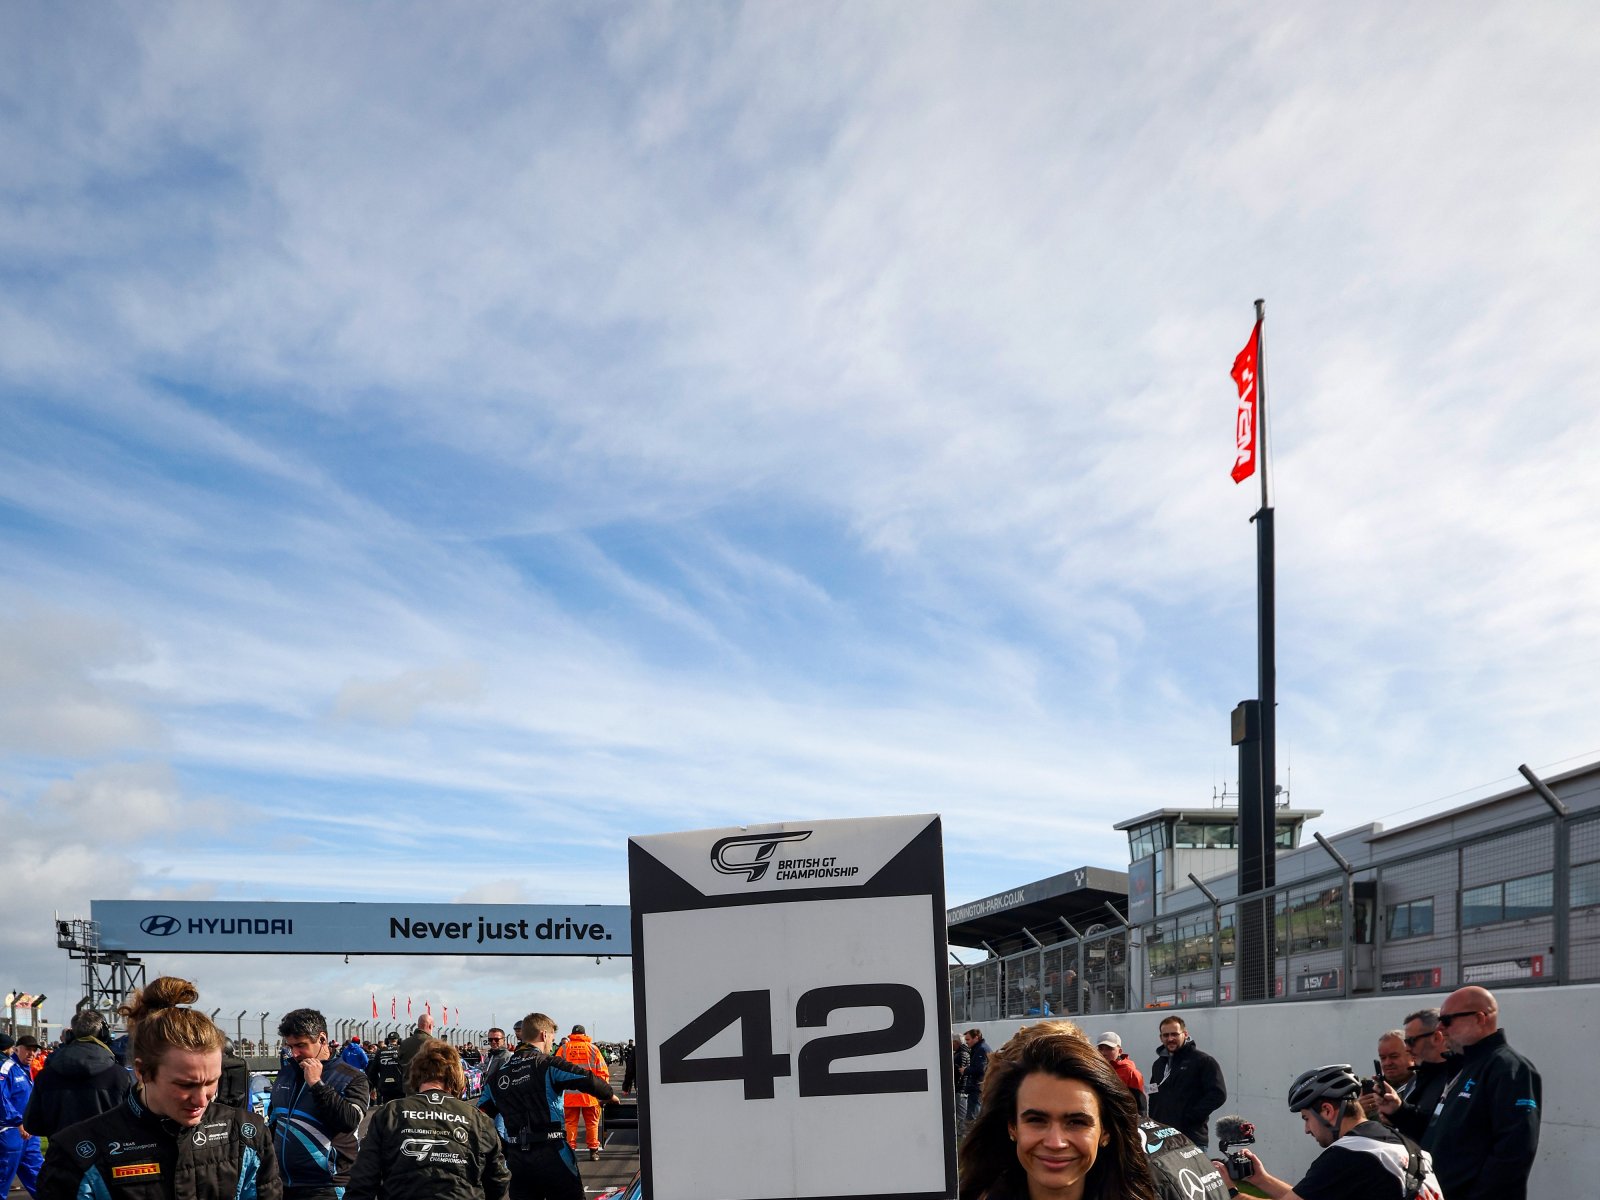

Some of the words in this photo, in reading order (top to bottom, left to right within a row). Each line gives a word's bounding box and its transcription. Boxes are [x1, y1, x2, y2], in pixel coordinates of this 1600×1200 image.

[778, 859, 819, 869] BRITISH
[822, 857, 837, 867] GT
[776, 866, 859, 880] CHAMPIONSHIP
[188, 918, 293, 935] HYUNDAI
[390, 917, 472, 939] Never
[477, 916, 528, 944] just
[535, 917, 612, 940] drive.
[659, 983, 929, 1101] 42
[402, 1110, 469, 1124] TECHNICAL
